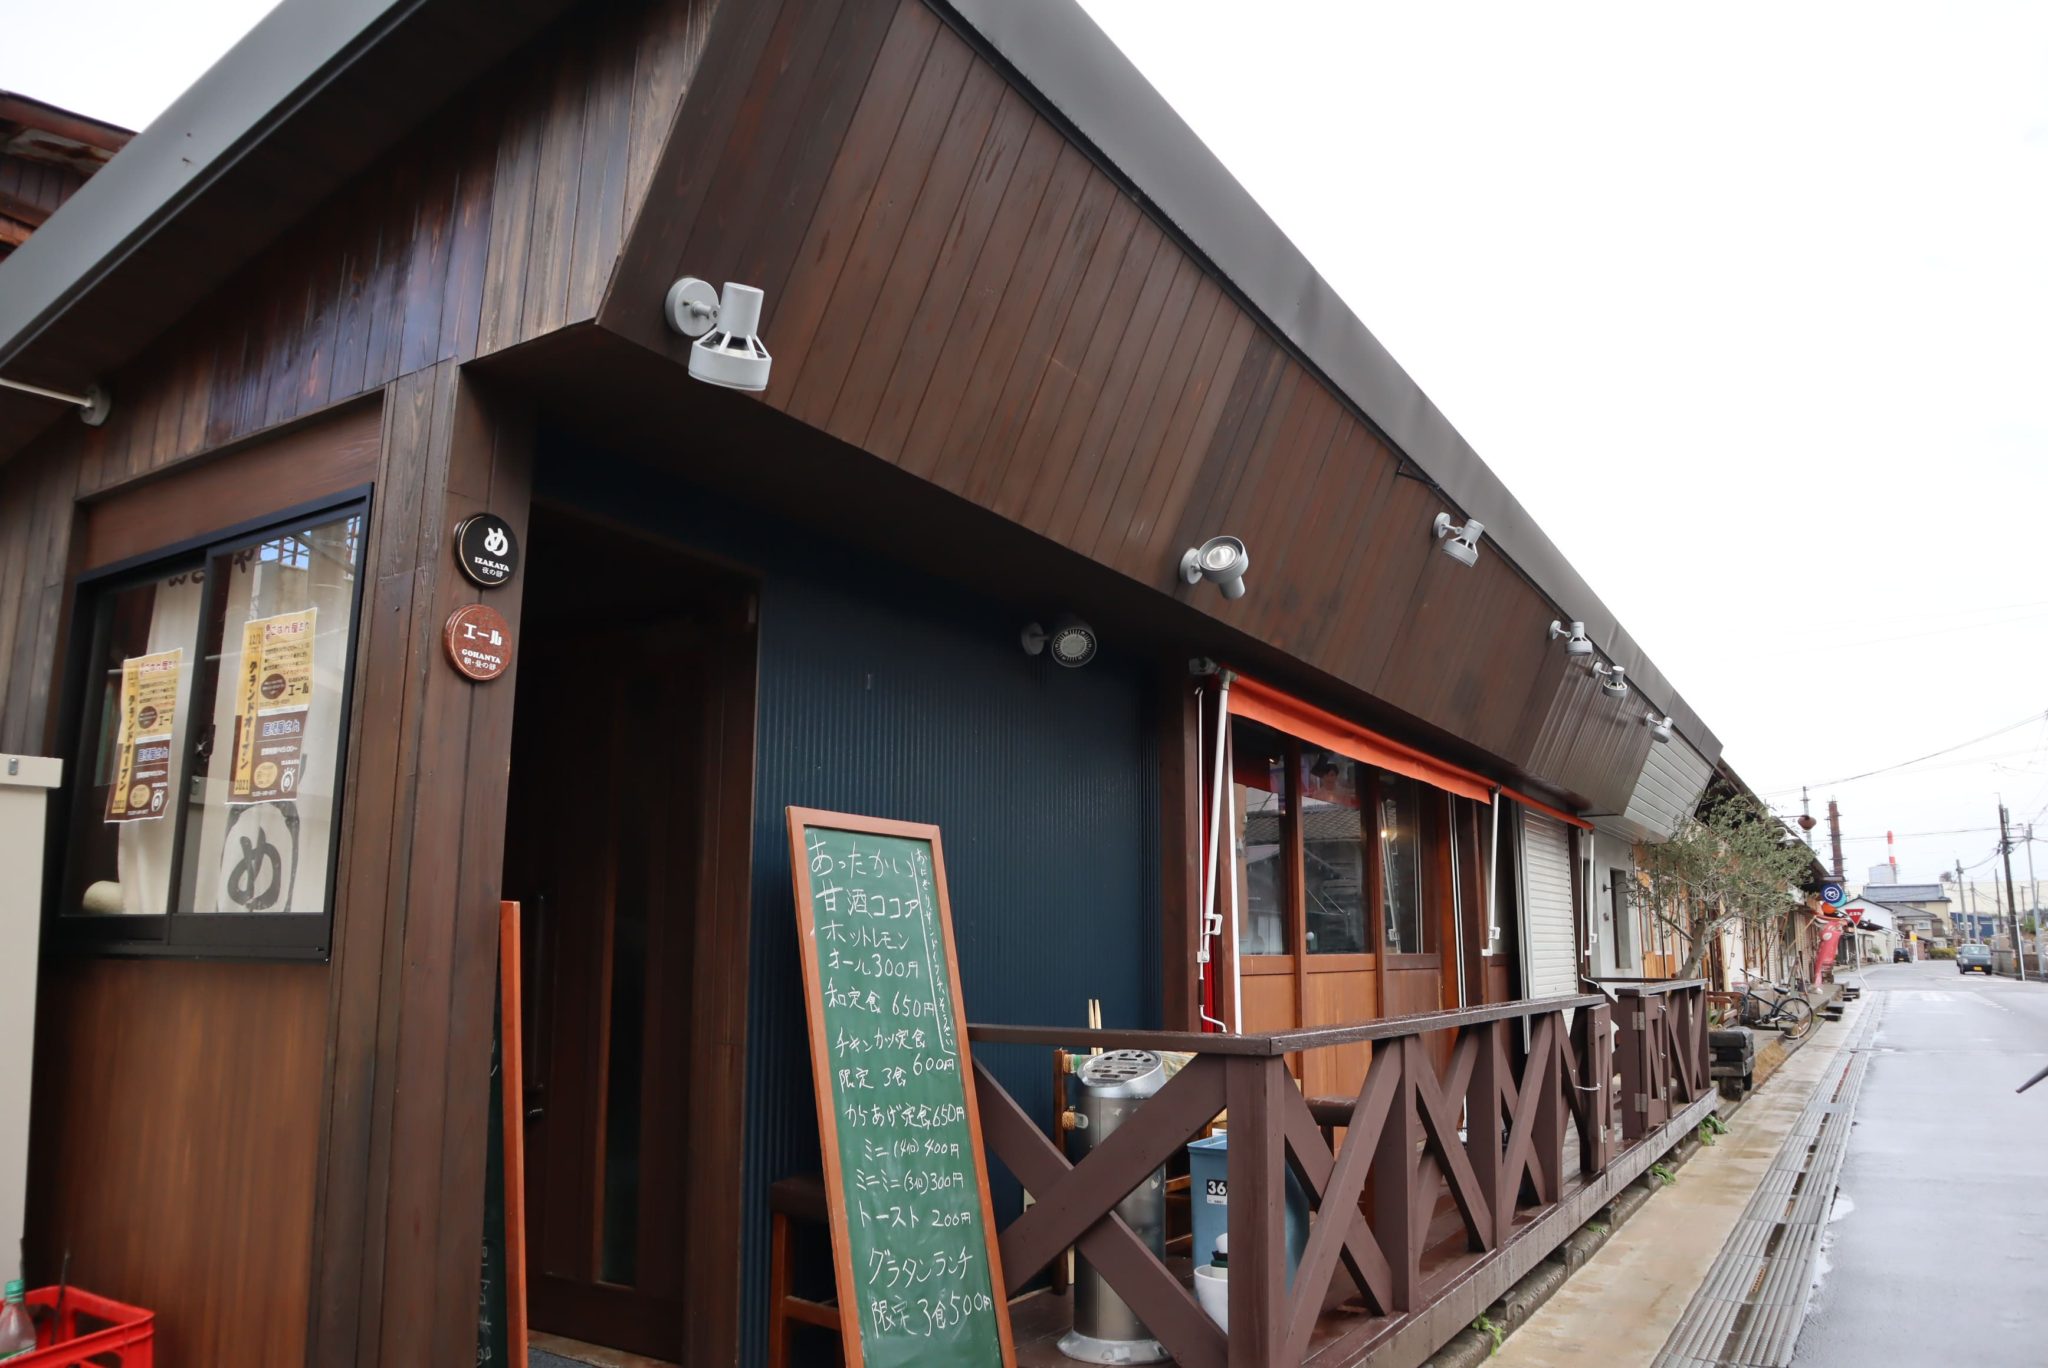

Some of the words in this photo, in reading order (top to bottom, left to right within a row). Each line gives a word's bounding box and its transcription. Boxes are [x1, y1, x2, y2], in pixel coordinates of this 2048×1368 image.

[474, 556, 510, 572] IZAKAYA
[463, 623, 502, 646] エール
[461, 648, 501, 664] GOHANYA
[808, 834, 914, 878] あったかい
[816, 879, 919, 918] 甘酒ココア
[821, 920, 910, 950] ホットレモン
[913, 1053, 954, 1076] 600円
[1208, 1180, 1227, 1196] 36
[859, 1200, 920, 1229] トースト
[931, 1209, 971, 1227] 200円
[869, 1245, 974, 1288] グラタンランチ
